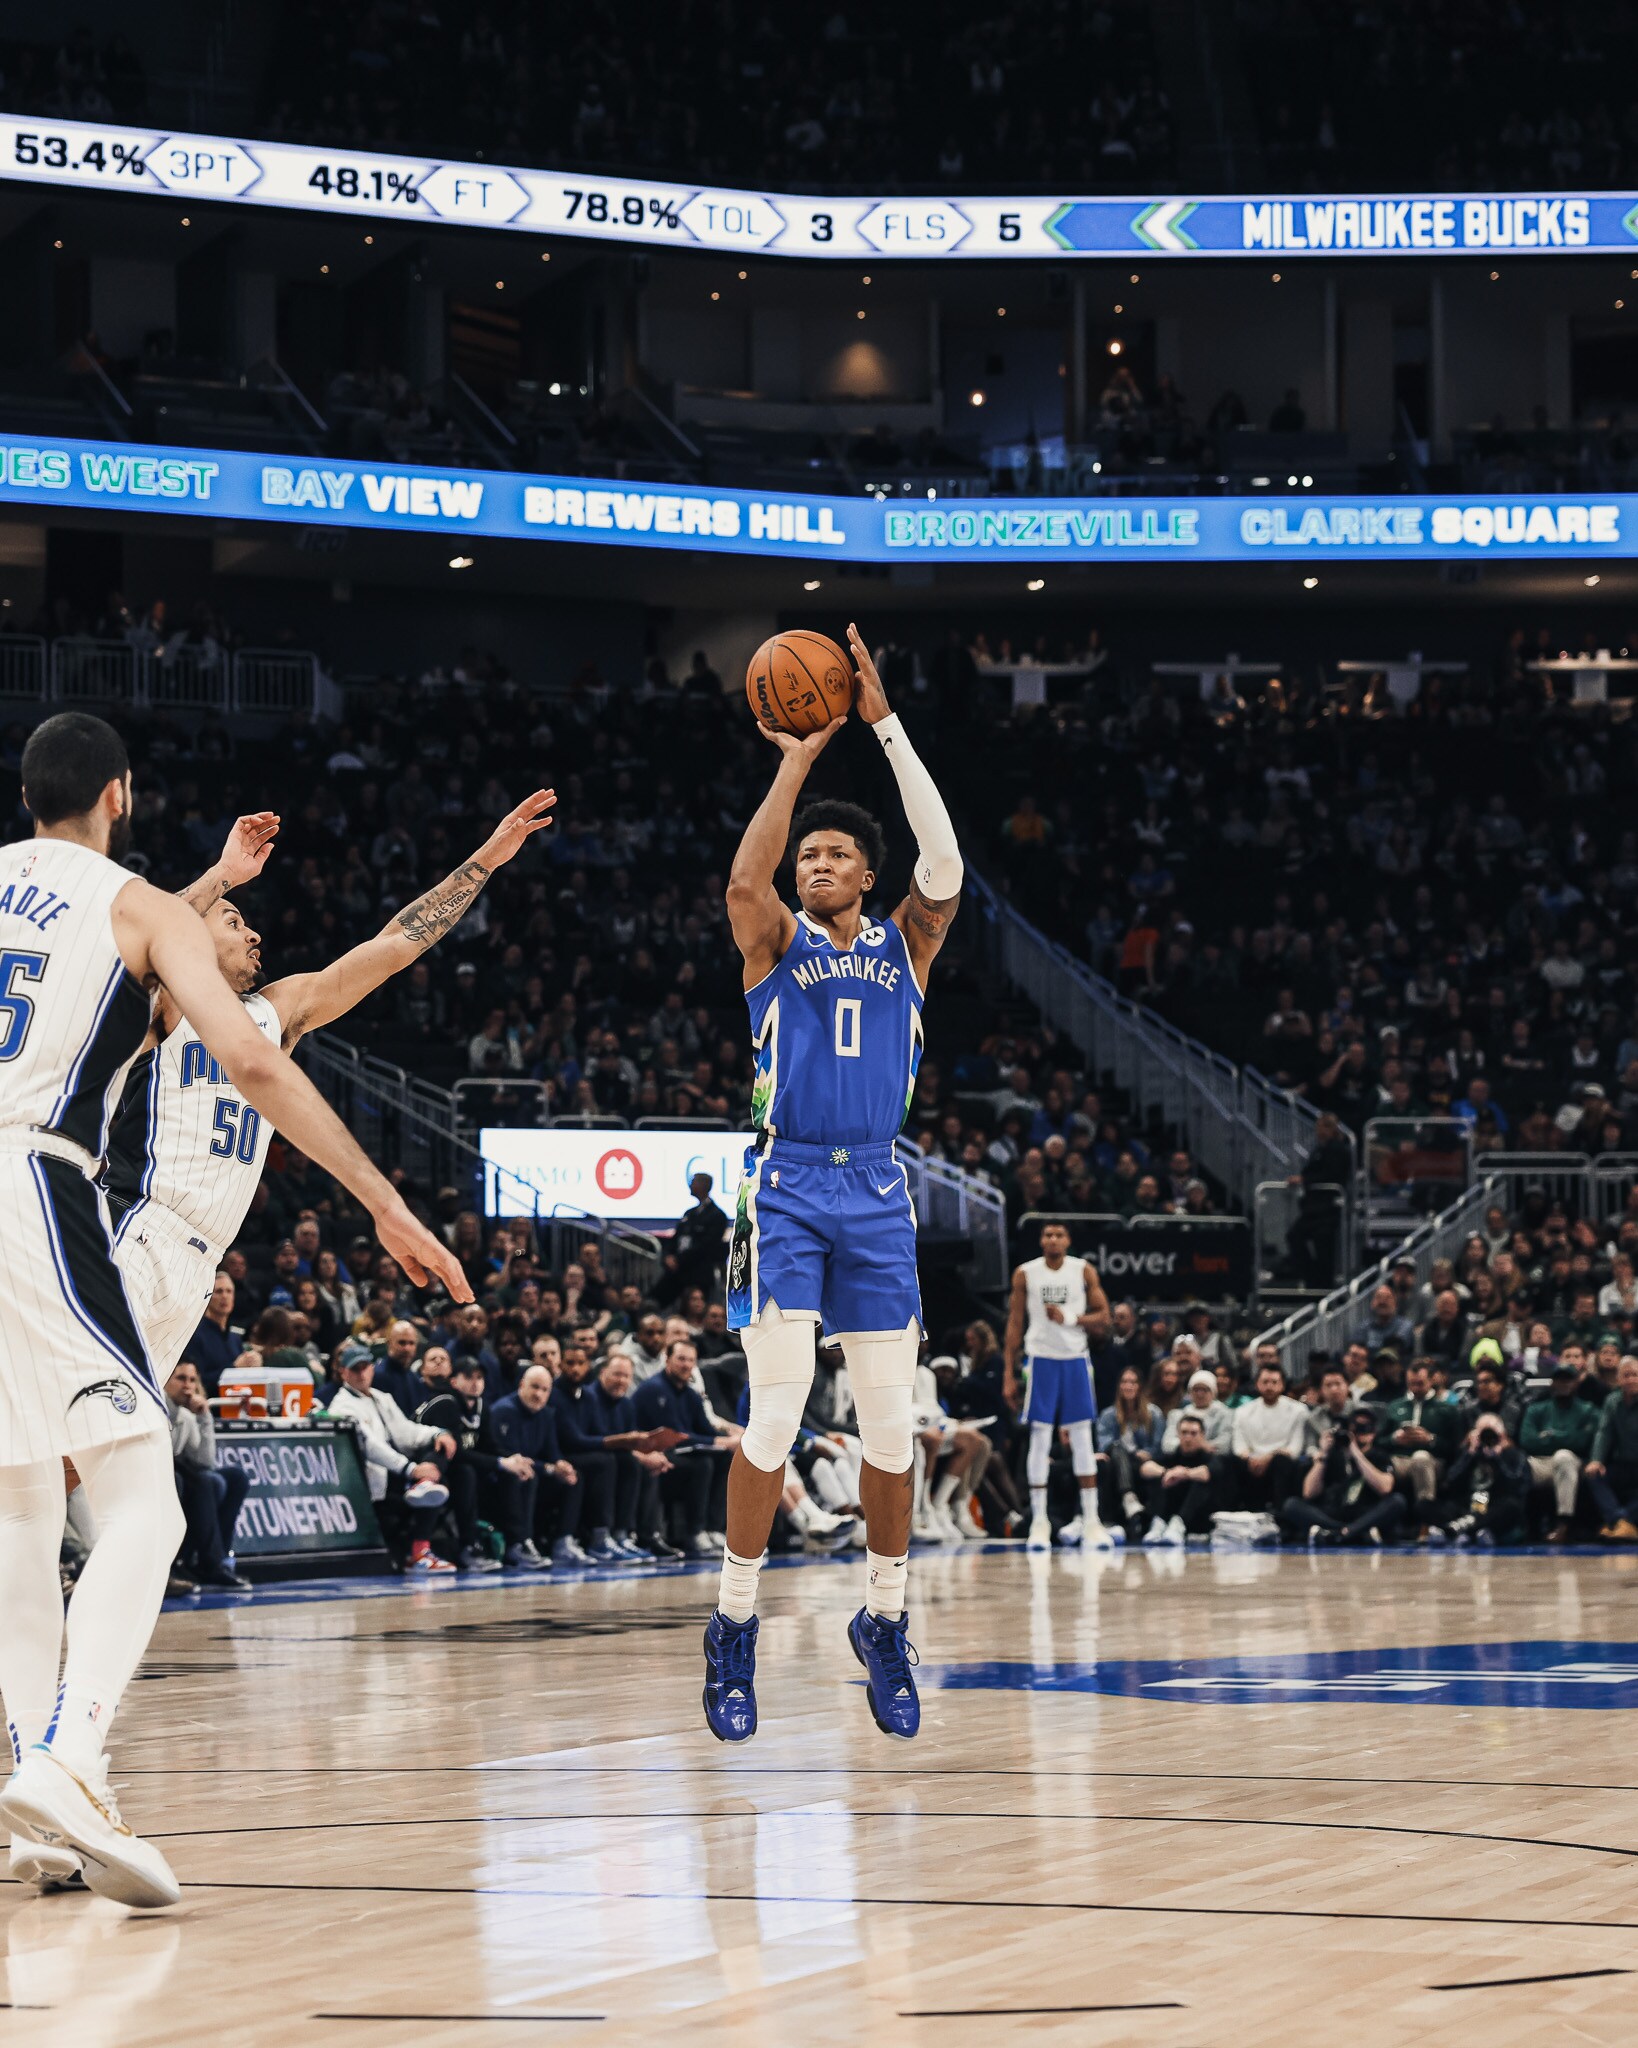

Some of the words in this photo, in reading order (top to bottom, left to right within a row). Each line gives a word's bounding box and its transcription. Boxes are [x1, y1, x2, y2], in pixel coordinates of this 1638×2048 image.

[15, 133, 145, 175] 53.4%
[169, 150, 237, 182] 3PT
[309, 165, 419, 203] 48.1%
[454, 179, 493, 208] FT
[563, 190, 678, 230] 78.9%
[703, 204, 761, 236] TOL
[811, 214, 833, 242] 3
[884, 214, 945, 240] FLS
[999, 214, 1021, 242] 5
[1242, 200, 1456, 249] MILWAUKEE
[1463, 199, 1590, 247] BUCKS
[81, 452, 219, 500] WEST
[262, 466, 354, 509] BAY
[361, 474, 483, 519] VIEW
[524, 486, 741, 537] BREWERS
[748, 503, 845, 545] HILL
[884, 509, 1198, 547] BRONZEVILLE
[1241, 507, 1424, 544] CLARKE
[1431, 506, 1620, 546] SQUARE
[0, 884, 70, 931] ADZE
[433, 906, 449, 920] LAS
[447, 888, 473, 908] VEGAS
[792, 953, 901, 992] MILWAUKEE
[0, 948, 50, 1062] 5
[835, 998, 862, 1058] 0
[210, 1097, 261, 1165] 50
